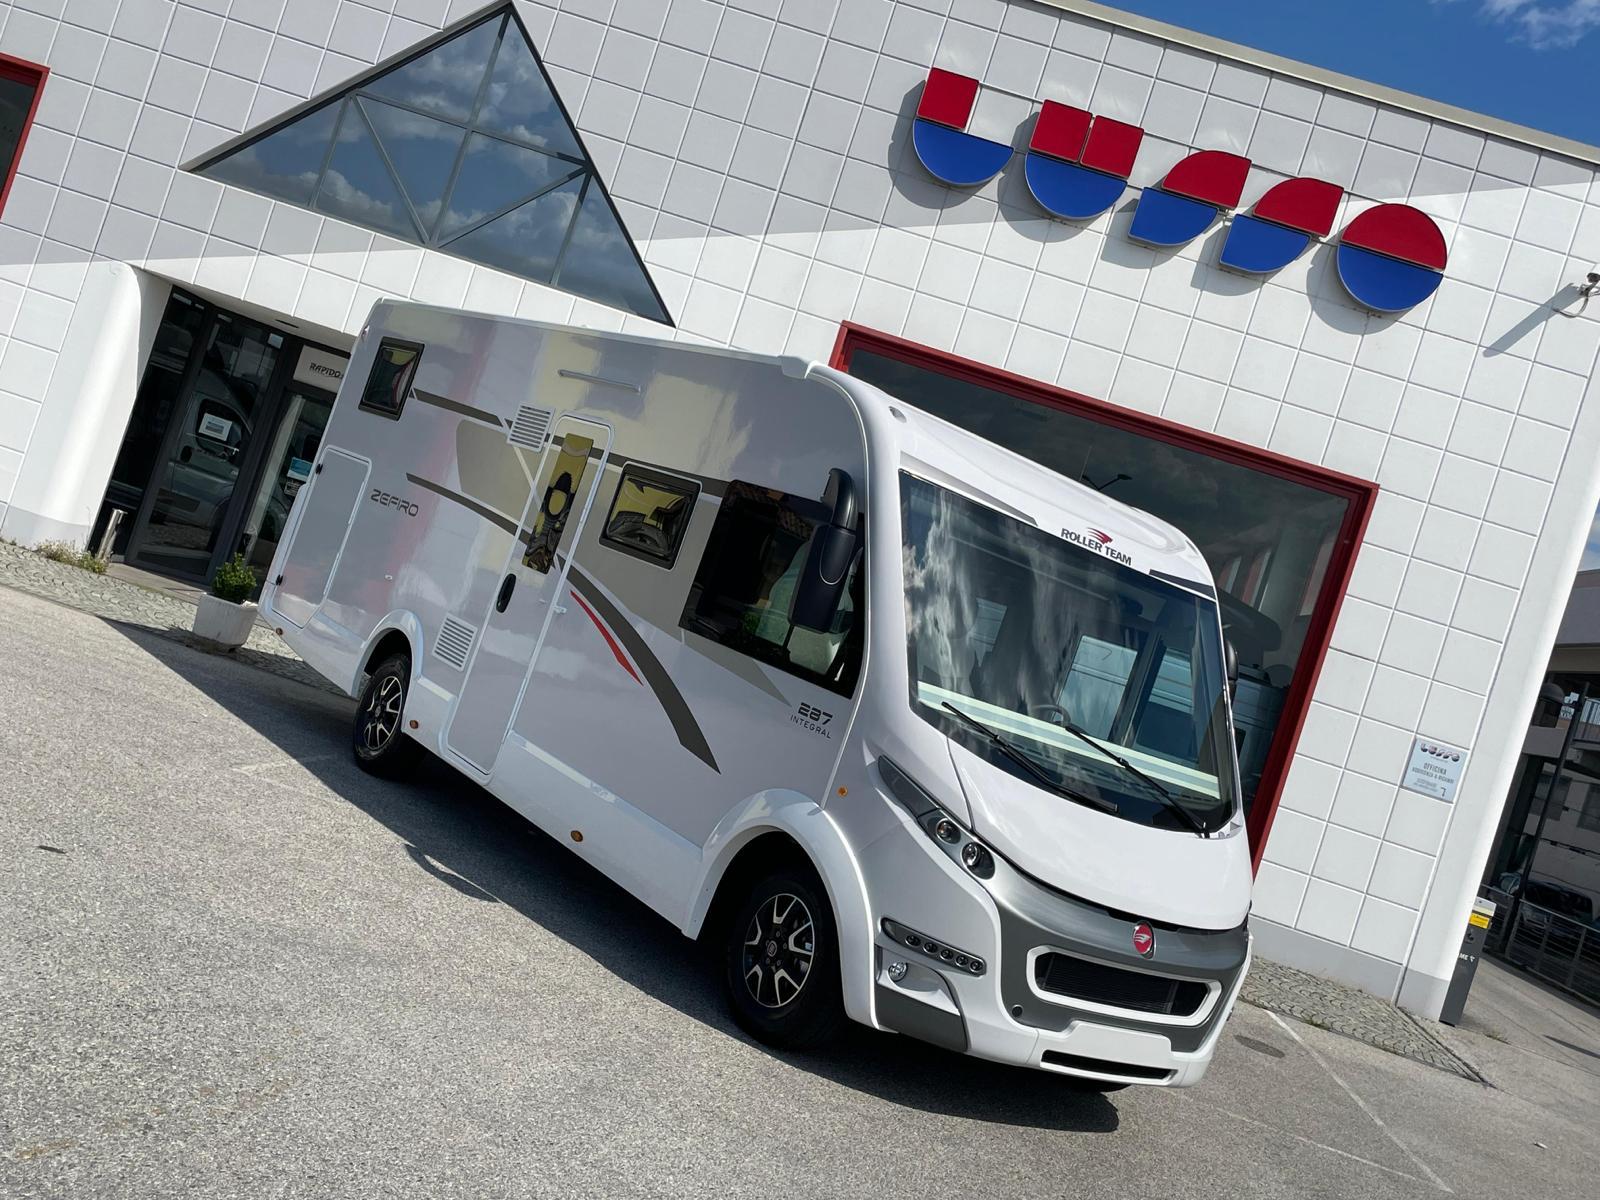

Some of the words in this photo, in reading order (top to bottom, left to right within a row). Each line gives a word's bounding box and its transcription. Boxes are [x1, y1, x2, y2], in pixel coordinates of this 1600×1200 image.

[371, 489, 419, 517] ZEFIRO
[1061, 528, 1103, 552] ROLLER
[1105, 546, 1132, 566] TEAM
[790, 714, 832, 739] INTEGRAL
[798, 702, 833, 725] 287
